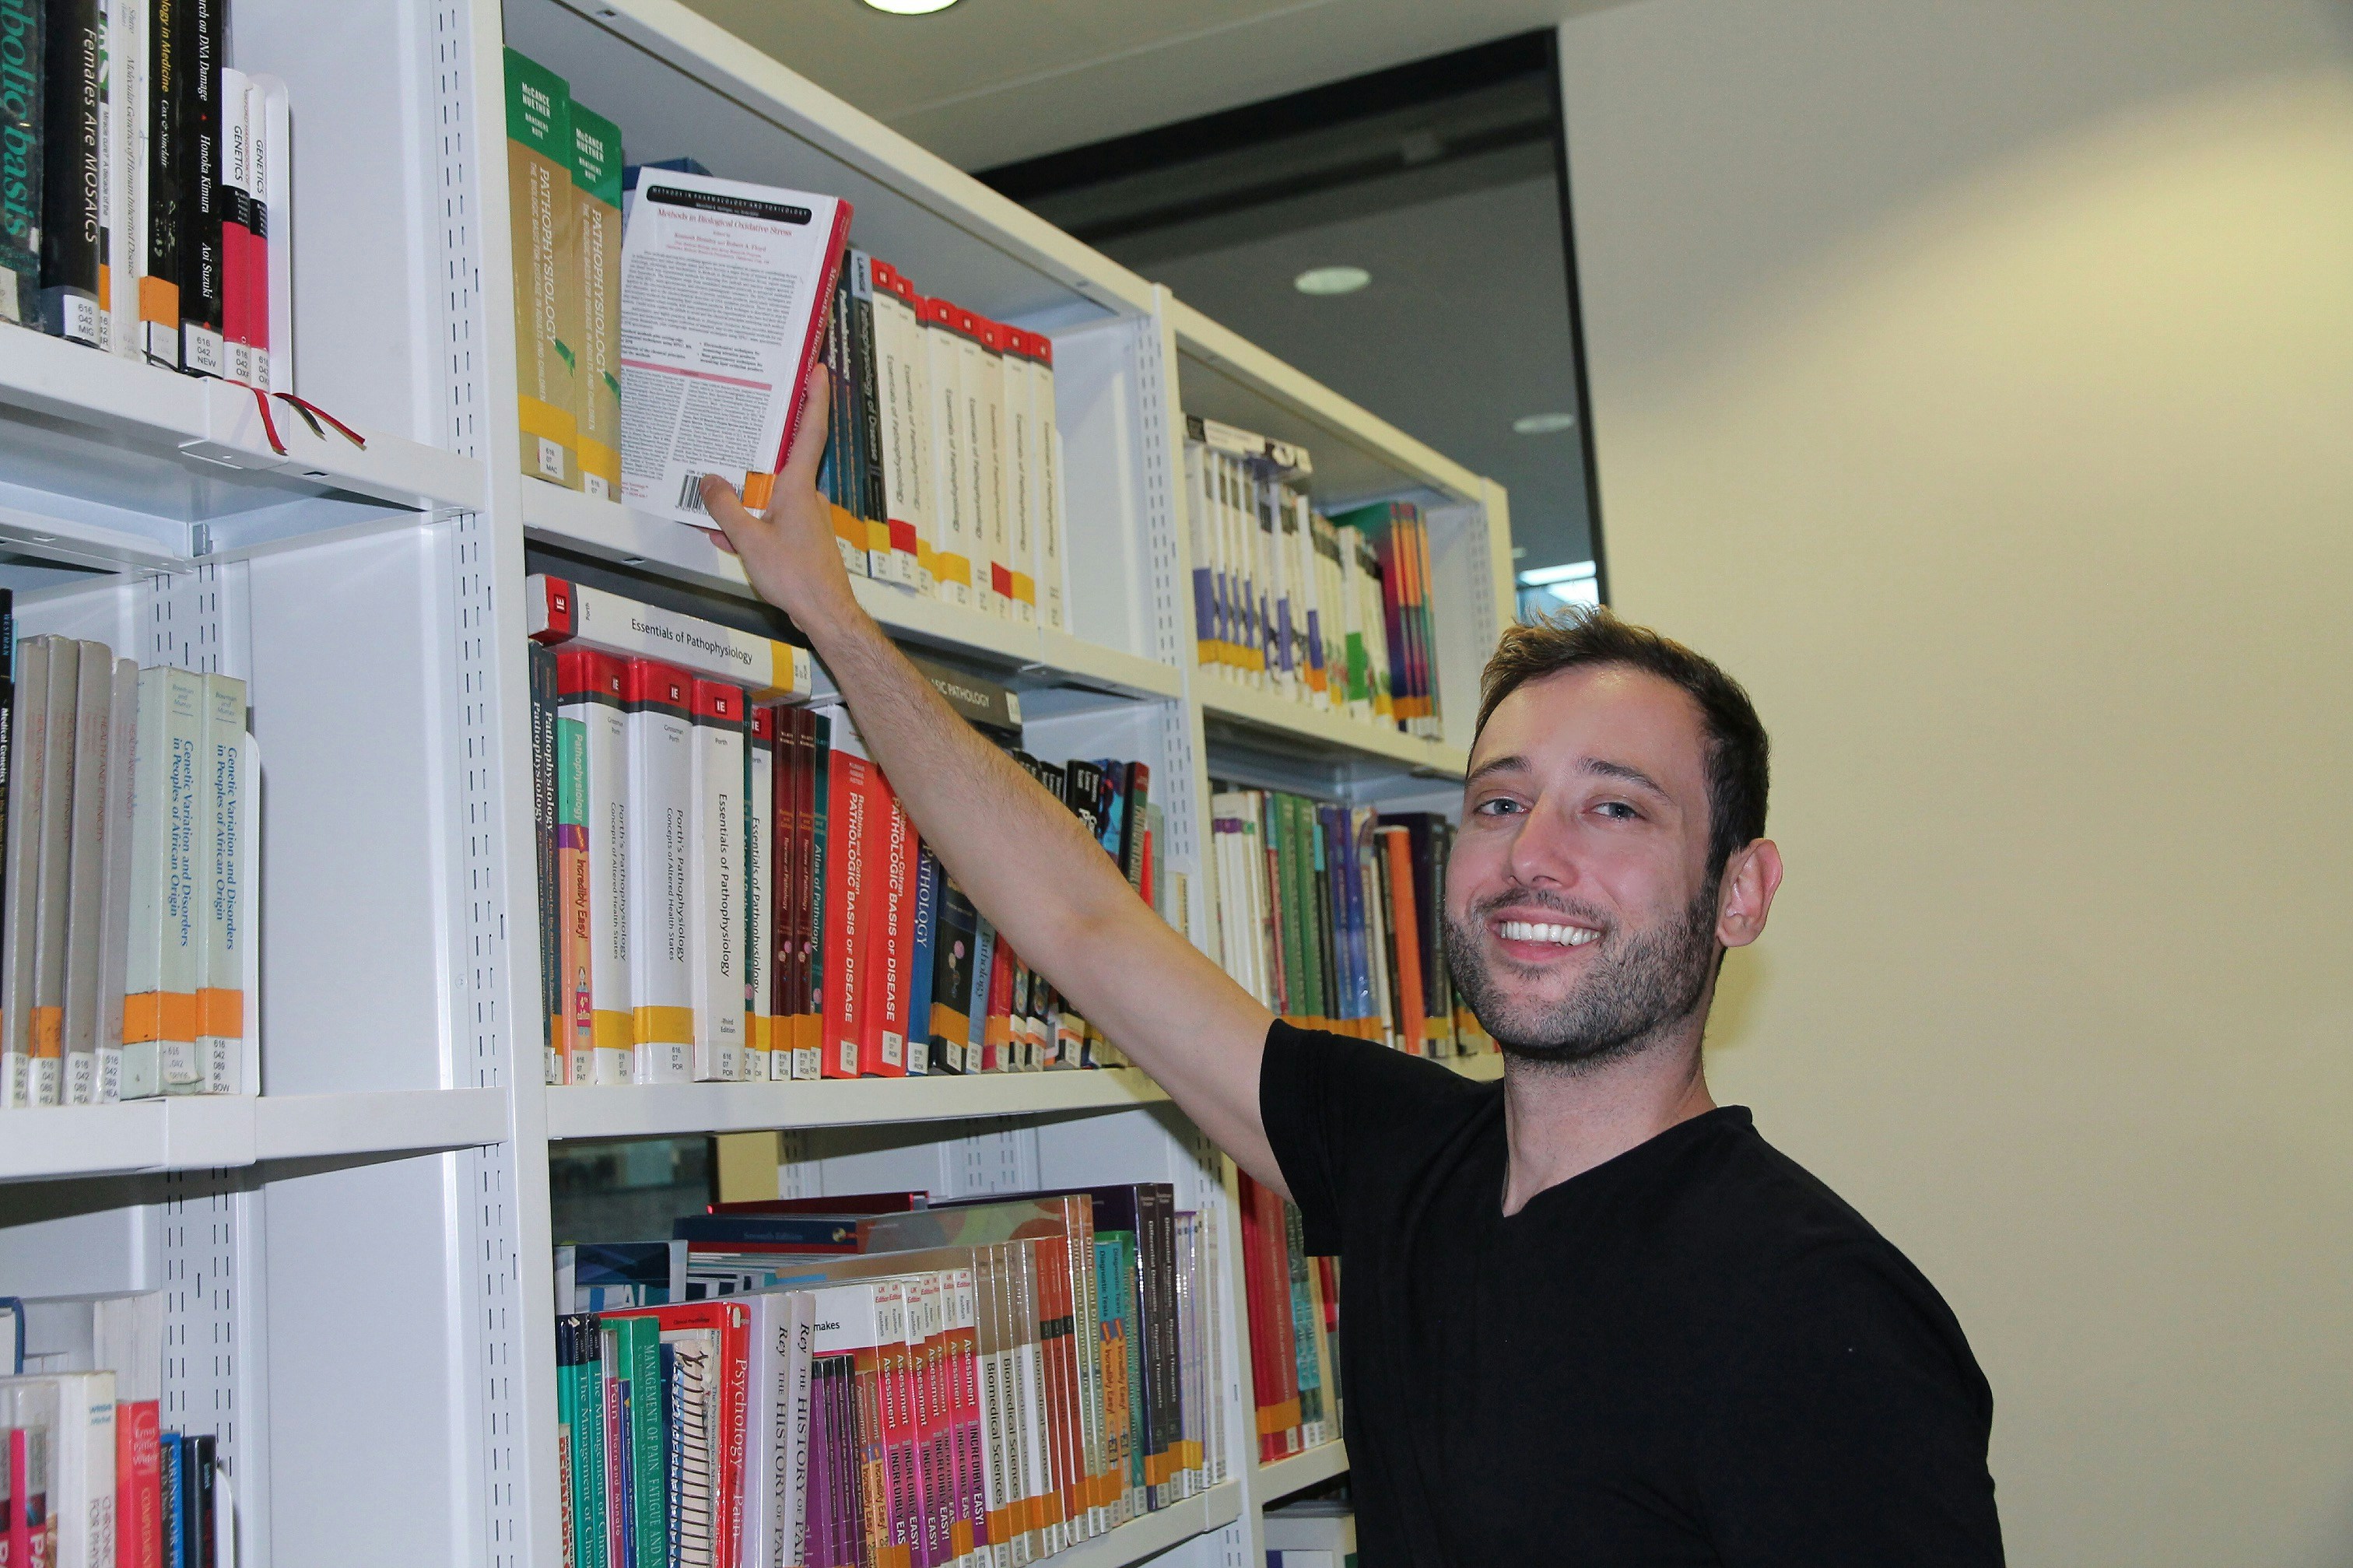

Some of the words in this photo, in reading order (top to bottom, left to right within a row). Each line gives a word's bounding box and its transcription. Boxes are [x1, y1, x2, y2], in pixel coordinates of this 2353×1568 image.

[162, 27, 171, 38] in
[199, 25, 208, 33] on
[199, 35, 209, 59] DNA
[84, 28, 97, 107] Females
[127, 56, 135, 103] Molecular
[161, 40, 171, 93] Medicine
[198, 61, 209, 101] Damage
[161, 100, 170, 119] Cox
[522, 93, 551, 119] HUETHER
[85, 112, 97, 146] Are
[127, 106, 135, 147] Genetics
[160, 131, 170, 168] Sinclair
[201, 134, 212, 174] Honoka
[234, 125, 244, 181] GENETICS
[256, 139, 265, 194] GENETICS
[4, 126, 37, 238] basis
[85, 153, 98, 243] MOSAICS
[201, 175, 212, 213] Kimura
[658, 208, 689, 222] Methods
[699, 215, 732, 228] Biological
[734, 221, 769, 233] Oxidative
[202, 242, 212, 261] Aoi
[539, 167, 556, 346] PATHOPHYSIOLOGY
[202, 263, 212, 299] Suzuki
[591, 208, 606, 379] PATHOPHYSIOLOGY
[78, 304, 93, 314] 616
[78, 315, 93, 325] 042
[79, 325, 94, 335] MIG
[196, 336, 211, 347] 616
[197, 346, 211, 357] 042
[198, 356, 216, 367] NEW
[556, 597, 566, 611] IE
[631, 619, 674, 640] Essentials
[675, 630, 686, 643] of
[686, 634, 752, 665] Pathophysiology
[612, 679, 619, 690] IE
[671, 688, 679, 700] IE
[947, 685, 990, 707] PATHOLOGY
[717, 700, 725, 712] IE
[217, 745, 226, 756] in
[533, 701, 543, 825] Pathophysiology
[215, 761, 226, 808] Peoples
[227, 747, 238, 795] Genetic
[544, 711, 555, 832] Pathophysiology
[573, 734, 584, 821] Pathophysiology
[217, 812, 226, 826] of
[227, 800, 237, 861] Variation
[676, 809, 685, 853] Porth's
[719, 794, 729, 853] Essentials
[847, 791, 858, 886] PATHOLOGIC
[216, 830, 226, 875] African
[611, 847, 618, 857] of
[889, 797, 900, 888] PATHOLOGIC
[227, 863, 237, 885] and
[576, 859, 587, 907] Incredibly
[721, 857, 730, 871] of
[814, 877, 822, 889] of
[214, 879, 226, 921] Origin
[619, 853, 627, 962] Pathophysiology
[675, 857, 686, 963] Pathophysiology
[847, 889, 857, 935] BASIS
[888, 892, 898, 935] BASIS
[917, 844, 934, 947] PATHOLOGY
[226, 889, 236, 950] Disorders
[576, 910, 587, 940] Easy!
[719, 873, 731, 977] Pathophysiology
[812, 892, 821, 951] Pathology
[847, 938, 853, 954] OF
[888, 938, 895, 953] OF
[845, 956, 854, 1022] DISEASE
[886, 956, 896, 1020] DISEASE
[213, 1039, 225, 1048] 616
[721, 1026, 735, 1034] Edition
[213, 1051, 225, 1059] 042
[212, 1083, 230, 1092] BOW
[798, 1323, 810, 1353] Rey
[813, 1321, 840, 1331] makes
[594, 1371, 603, 1397] The
[644, 1343, 658, 1422] MANAGEMENT
[915, 1356, 928, 1426] Assessment
[964, 1339, 977, 1406] Assessment
[610, 1384, 619, 1419] Pain
[730, 1358, 748, 1468] Psychology
[986, 1363, 1001, 1439] Biomedical
[593, 1403, 605, 1494] Management
[647, 1427, 658, 1441] OF
[796, 1397, 808, 1493] HISTORY
[646, 1444, 659, 1474] PAIN,
[969, 1428, 981, 1493] INCREDIBLY
[991, 1444, 1003, 1504] Sciences
[922, 1449, 935, 1516] INCREDIBLY
[598, 1501, 606, 1516] of
[647, 1479, 660, 1527] FATIGUE
[732, 1493, 743, 1536] Pain
[796, 1499, 804, 1514] OF
[973, 1493, 984, 1526] EASY!
[650, 1531, 661, 1553] AND
[927, 1517, 938, 1551] EASY!
